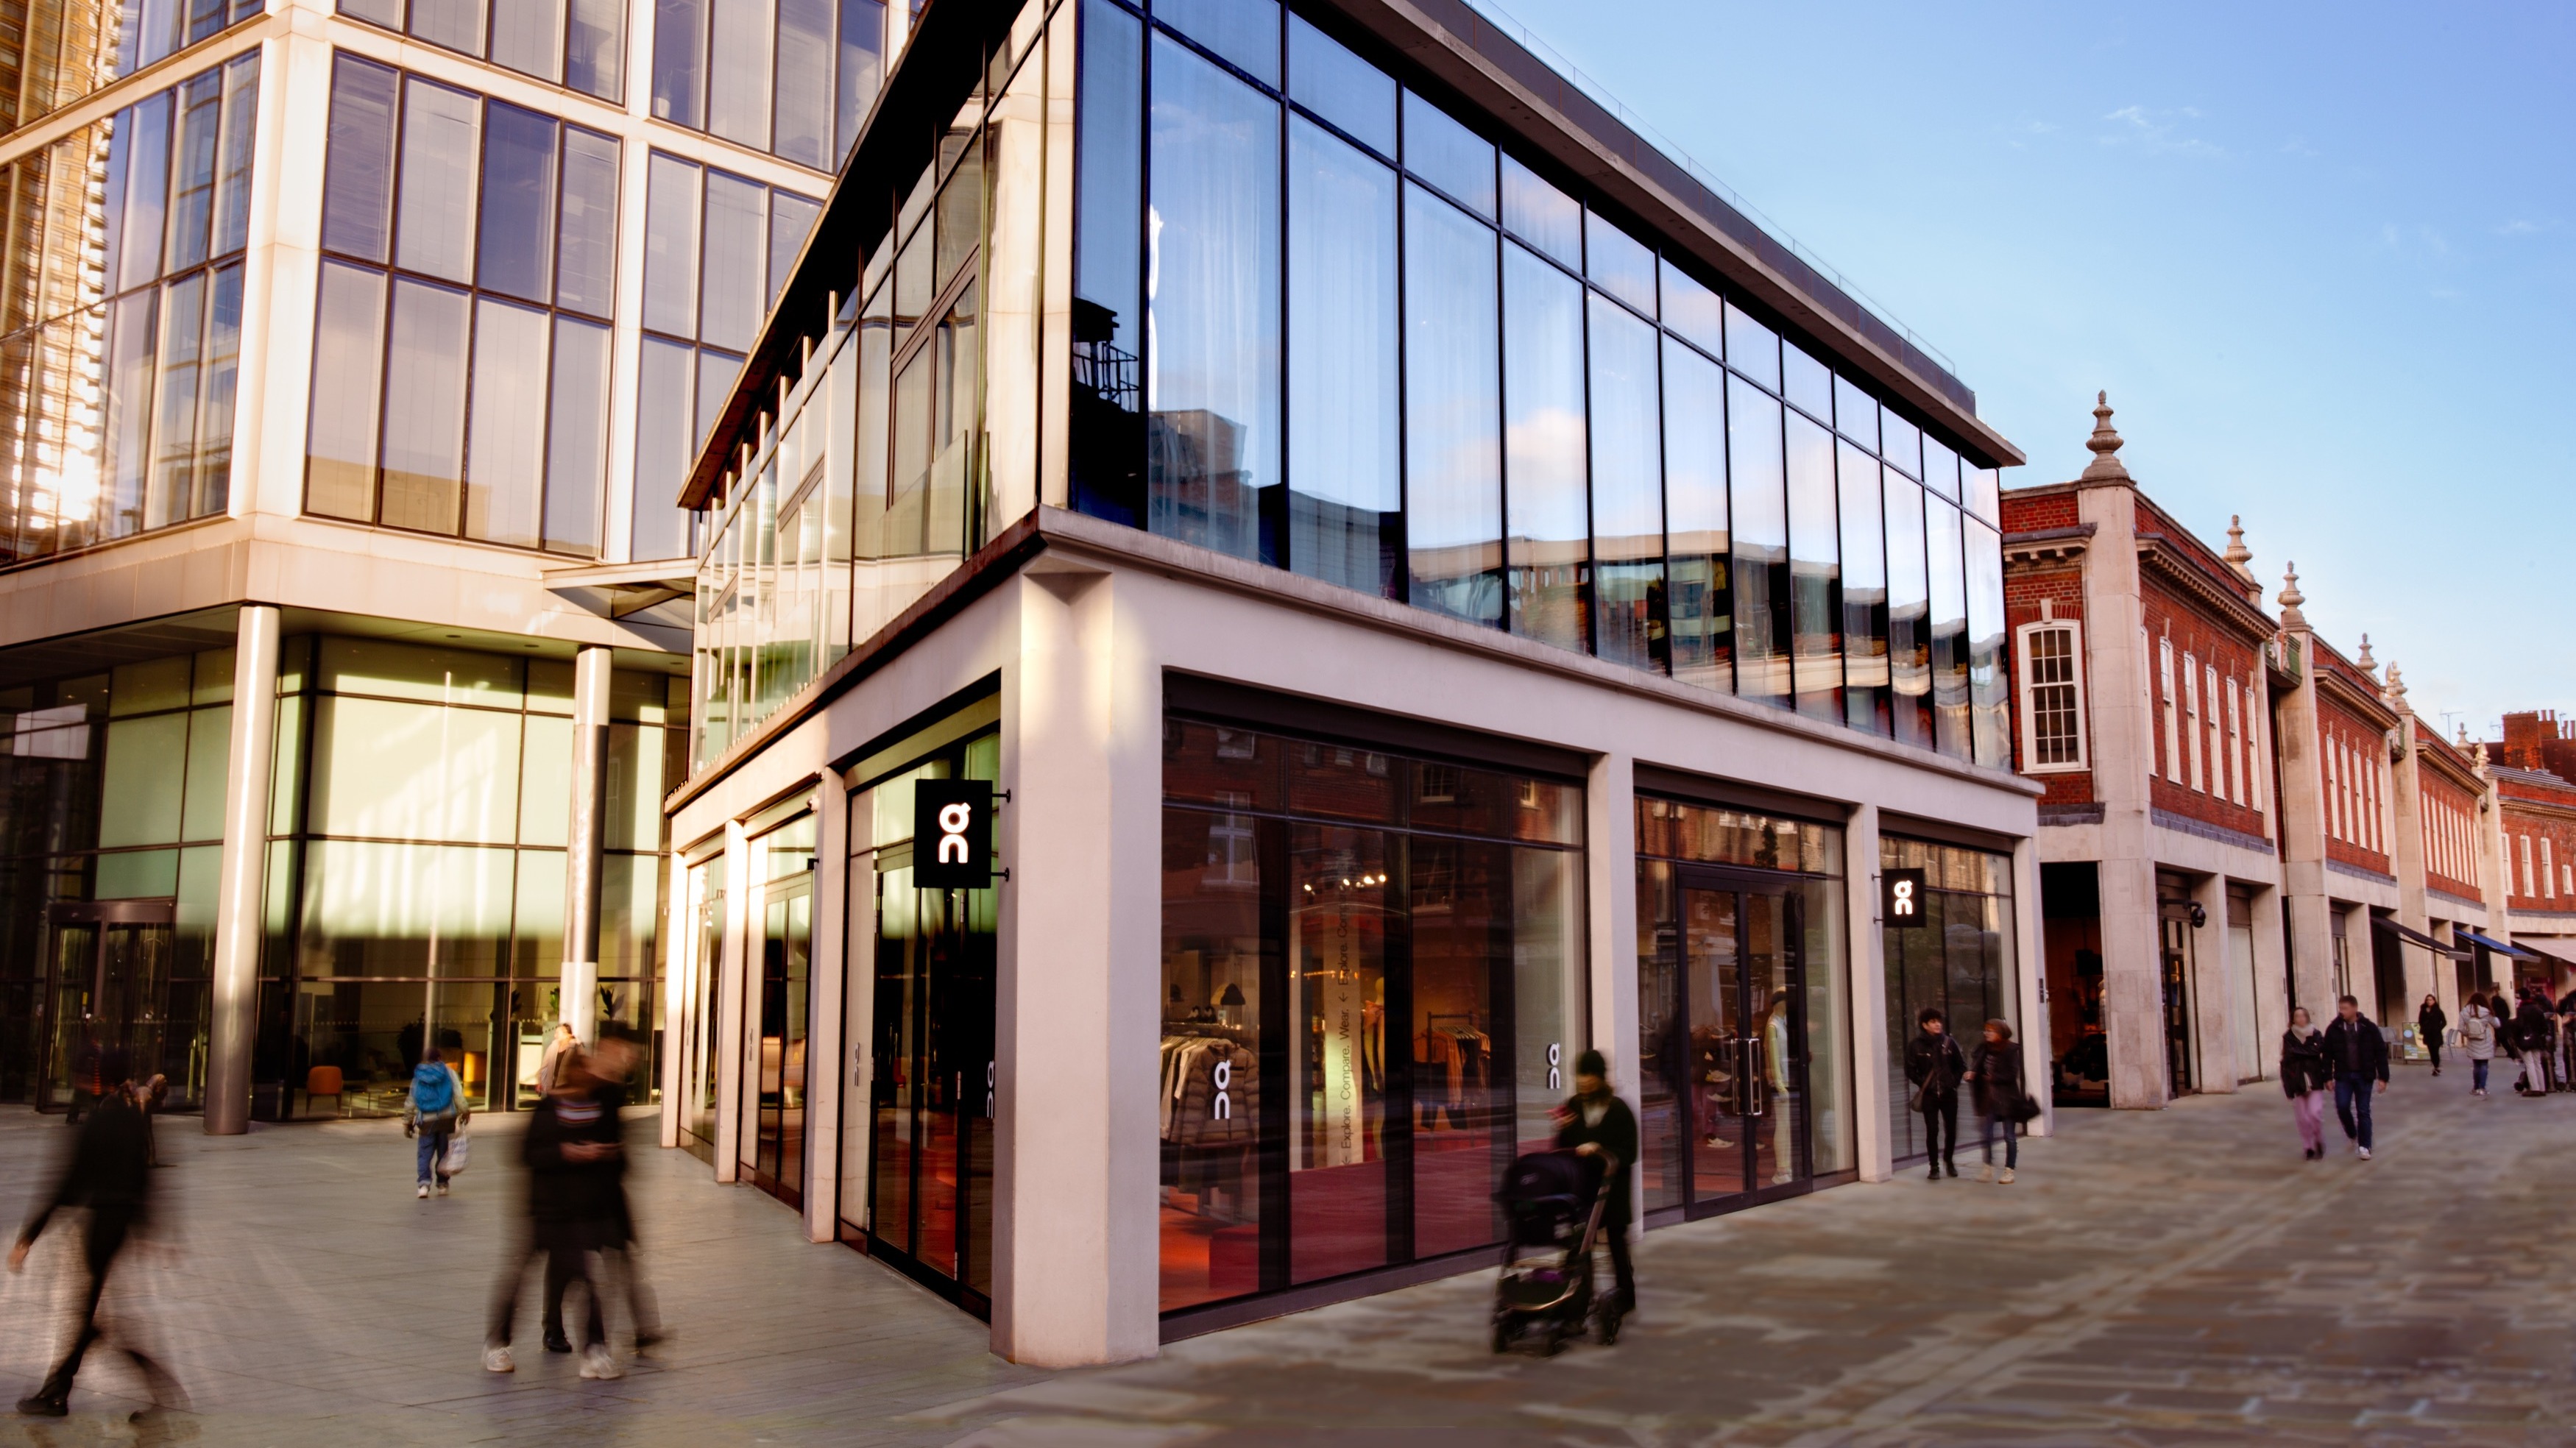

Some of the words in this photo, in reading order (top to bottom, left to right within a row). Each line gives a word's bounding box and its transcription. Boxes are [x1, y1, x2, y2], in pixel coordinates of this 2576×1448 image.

[1340, 1009, 1349, 1040] Wear.
[1340, 1045, 1353, 1100] Compare.
[1341, 1105, 1353, 1149] Explore.
